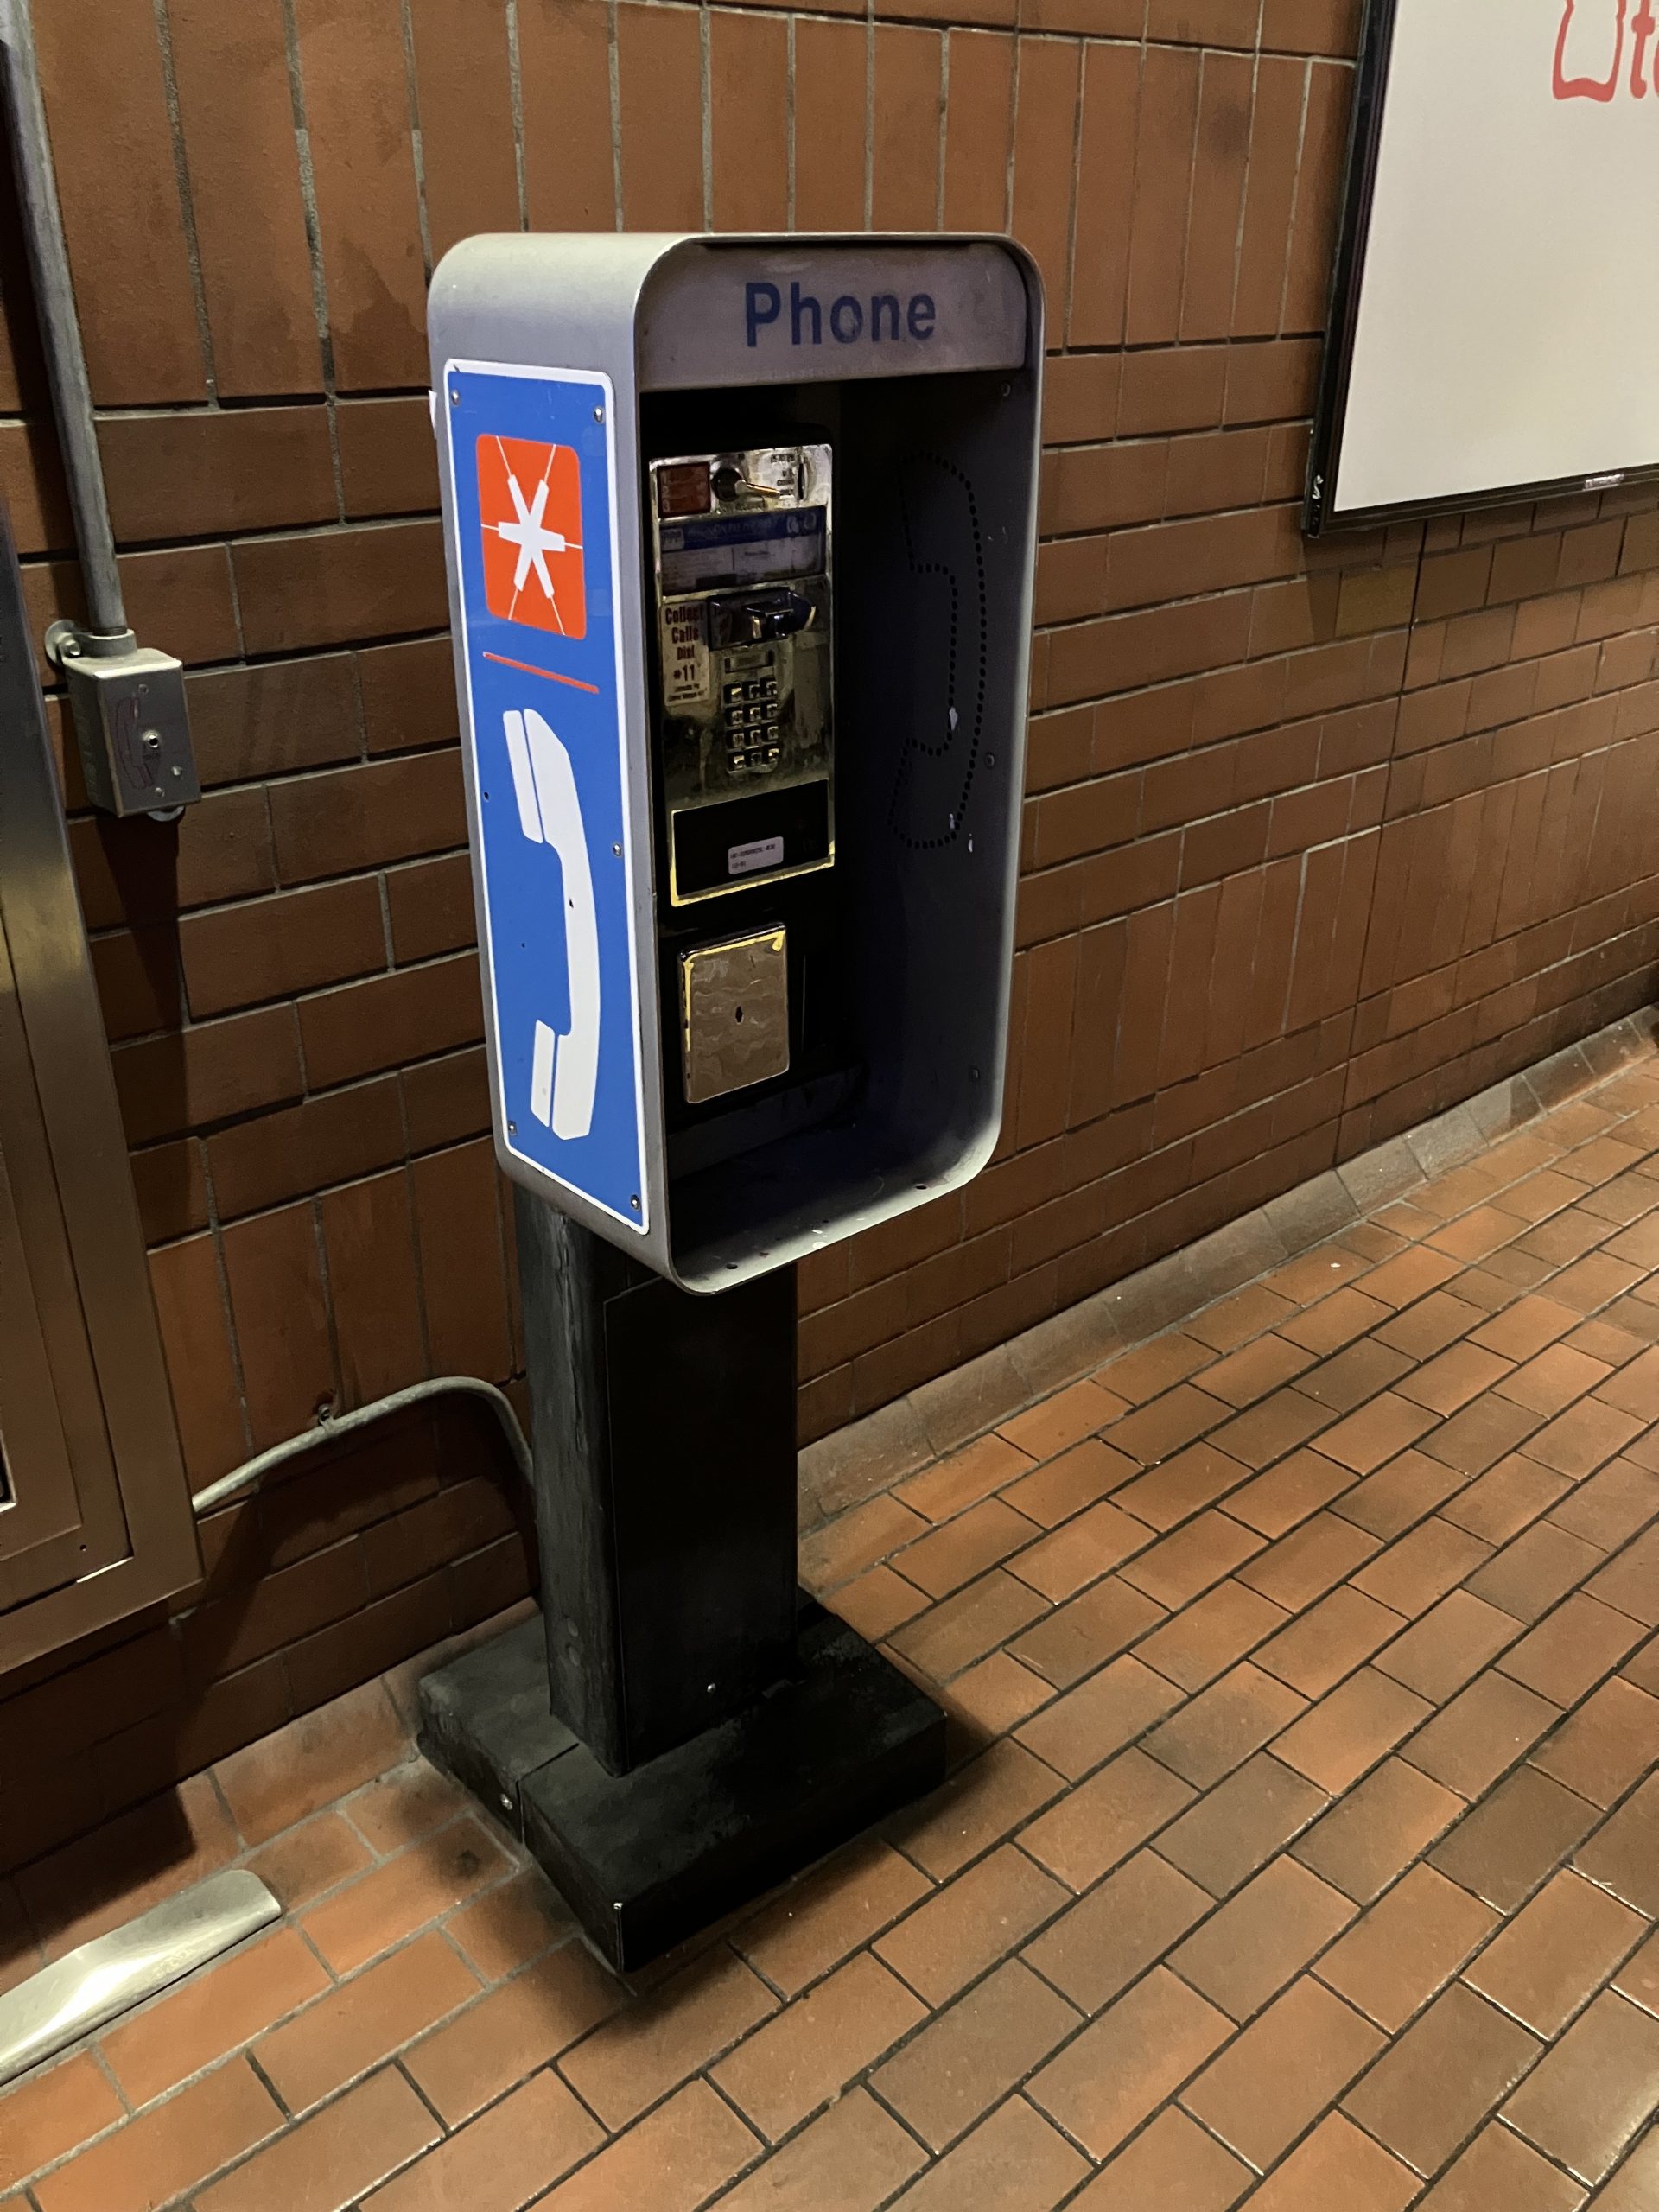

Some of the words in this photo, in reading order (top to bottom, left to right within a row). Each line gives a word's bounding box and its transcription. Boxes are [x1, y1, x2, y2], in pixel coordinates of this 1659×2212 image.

[746, 282, 936, 347] Phone
[665, 605, 703, 625] Collect
[671, 625, 699, 644] Calls
[677, 645, 696, 661] Dial
